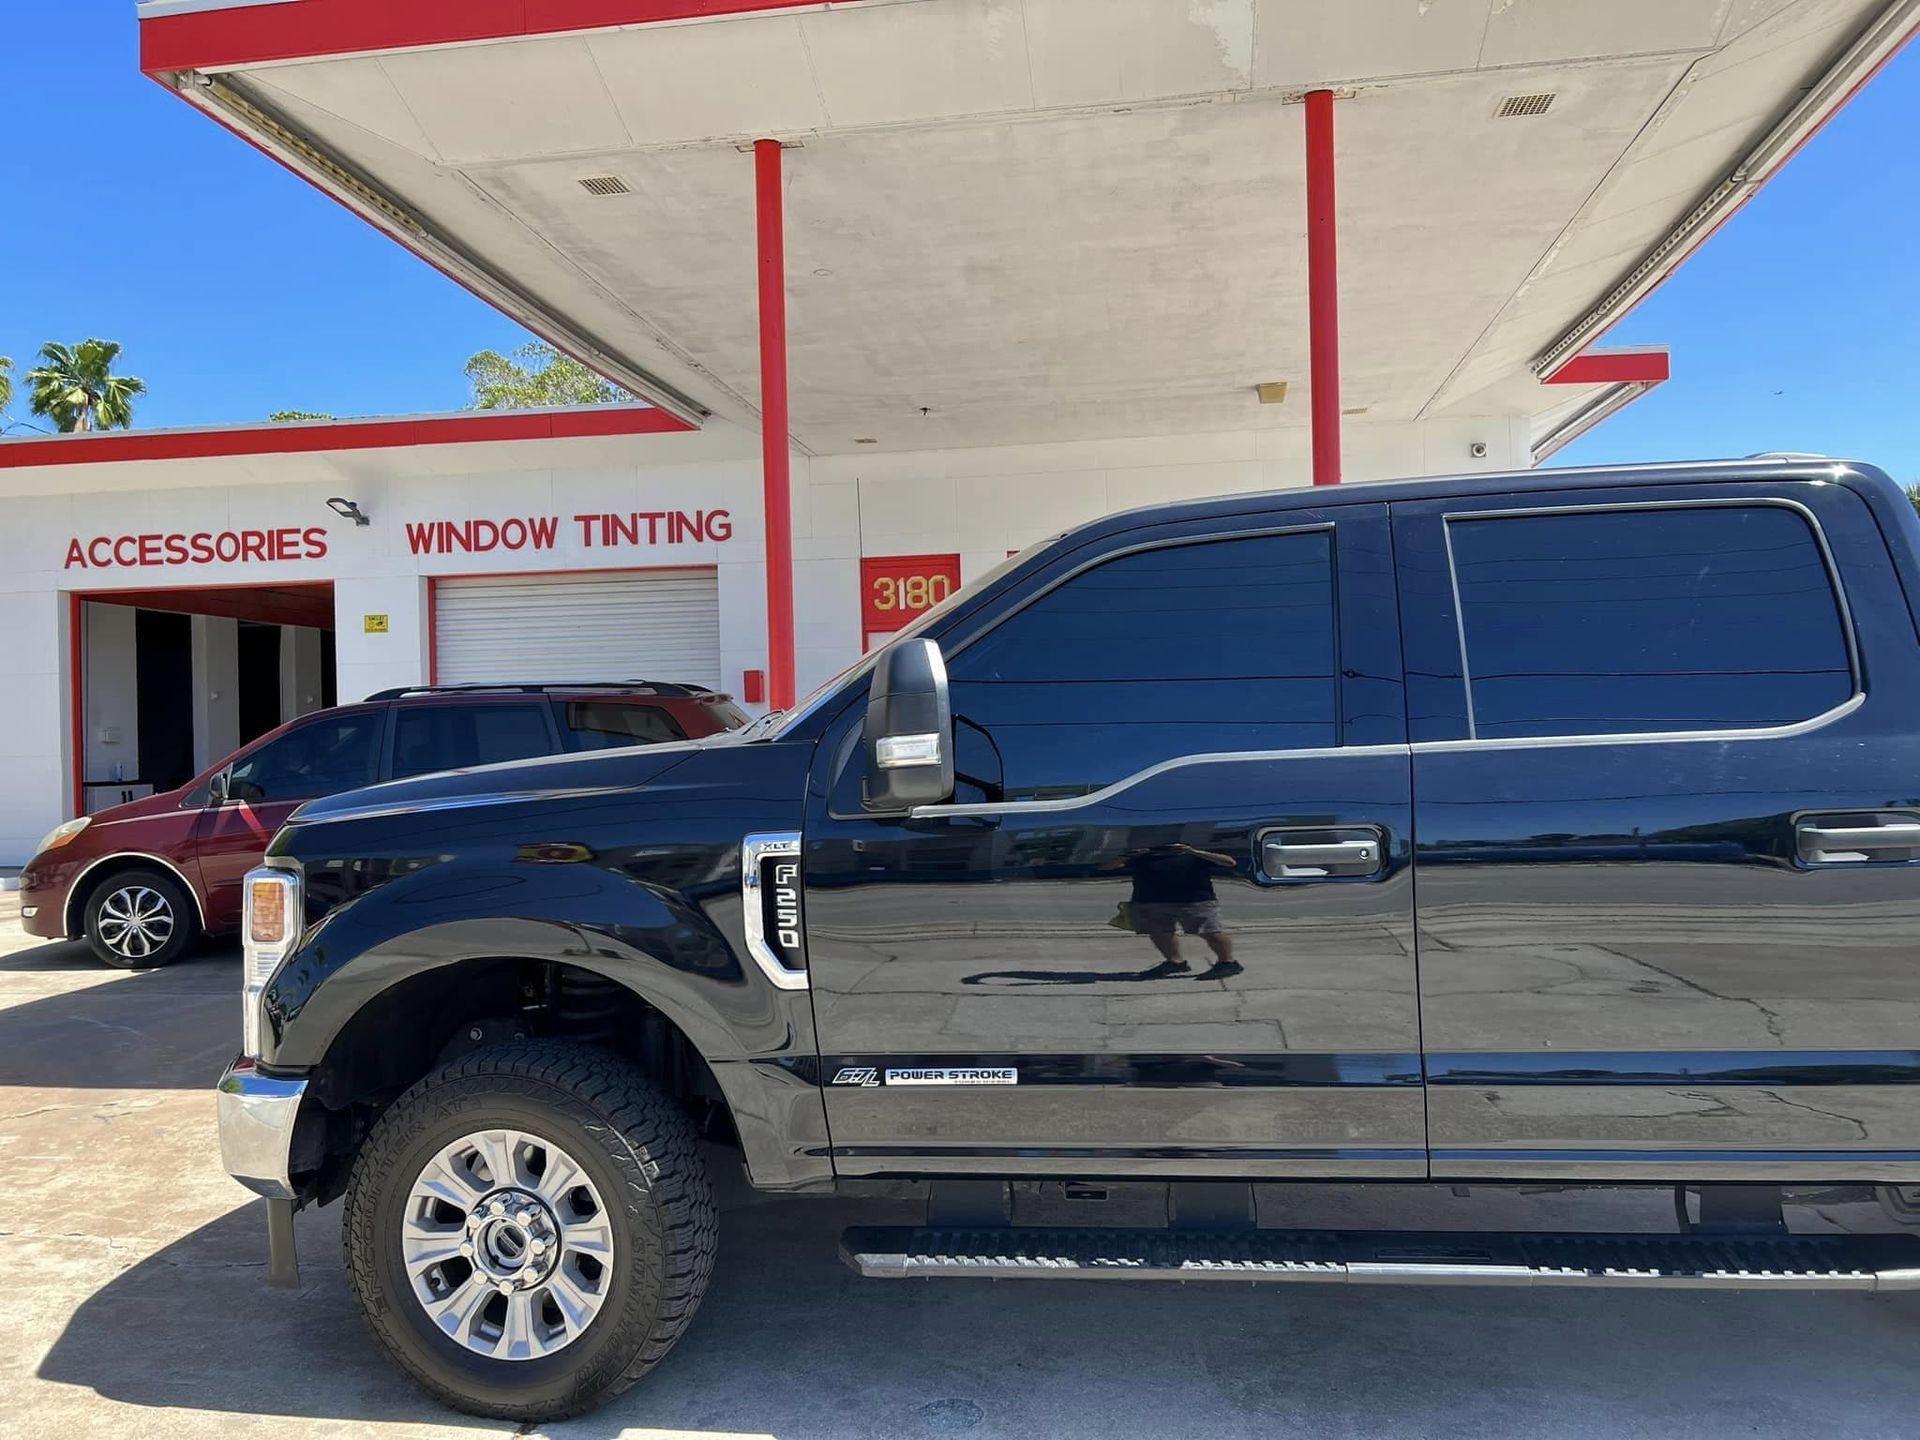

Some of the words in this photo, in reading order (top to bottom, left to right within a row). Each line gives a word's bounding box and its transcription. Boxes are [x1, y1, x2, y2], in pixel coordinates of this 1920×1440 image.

[63, 526, 329, 570] ACCESSORIES
[405, 515, 559, 555] WINDOW
[573, 508, 733, 549] TINTING
[873, 574, 952, 611] 3180
[762, 842, 790, 850] XLT
[774, 863, 800, 949] F250
[889, 1069, 944, 1080] POWER
[947, 1069, 1013, 1080] STROKE
[361, 1120, 427, 1317] ENCOUNTER
